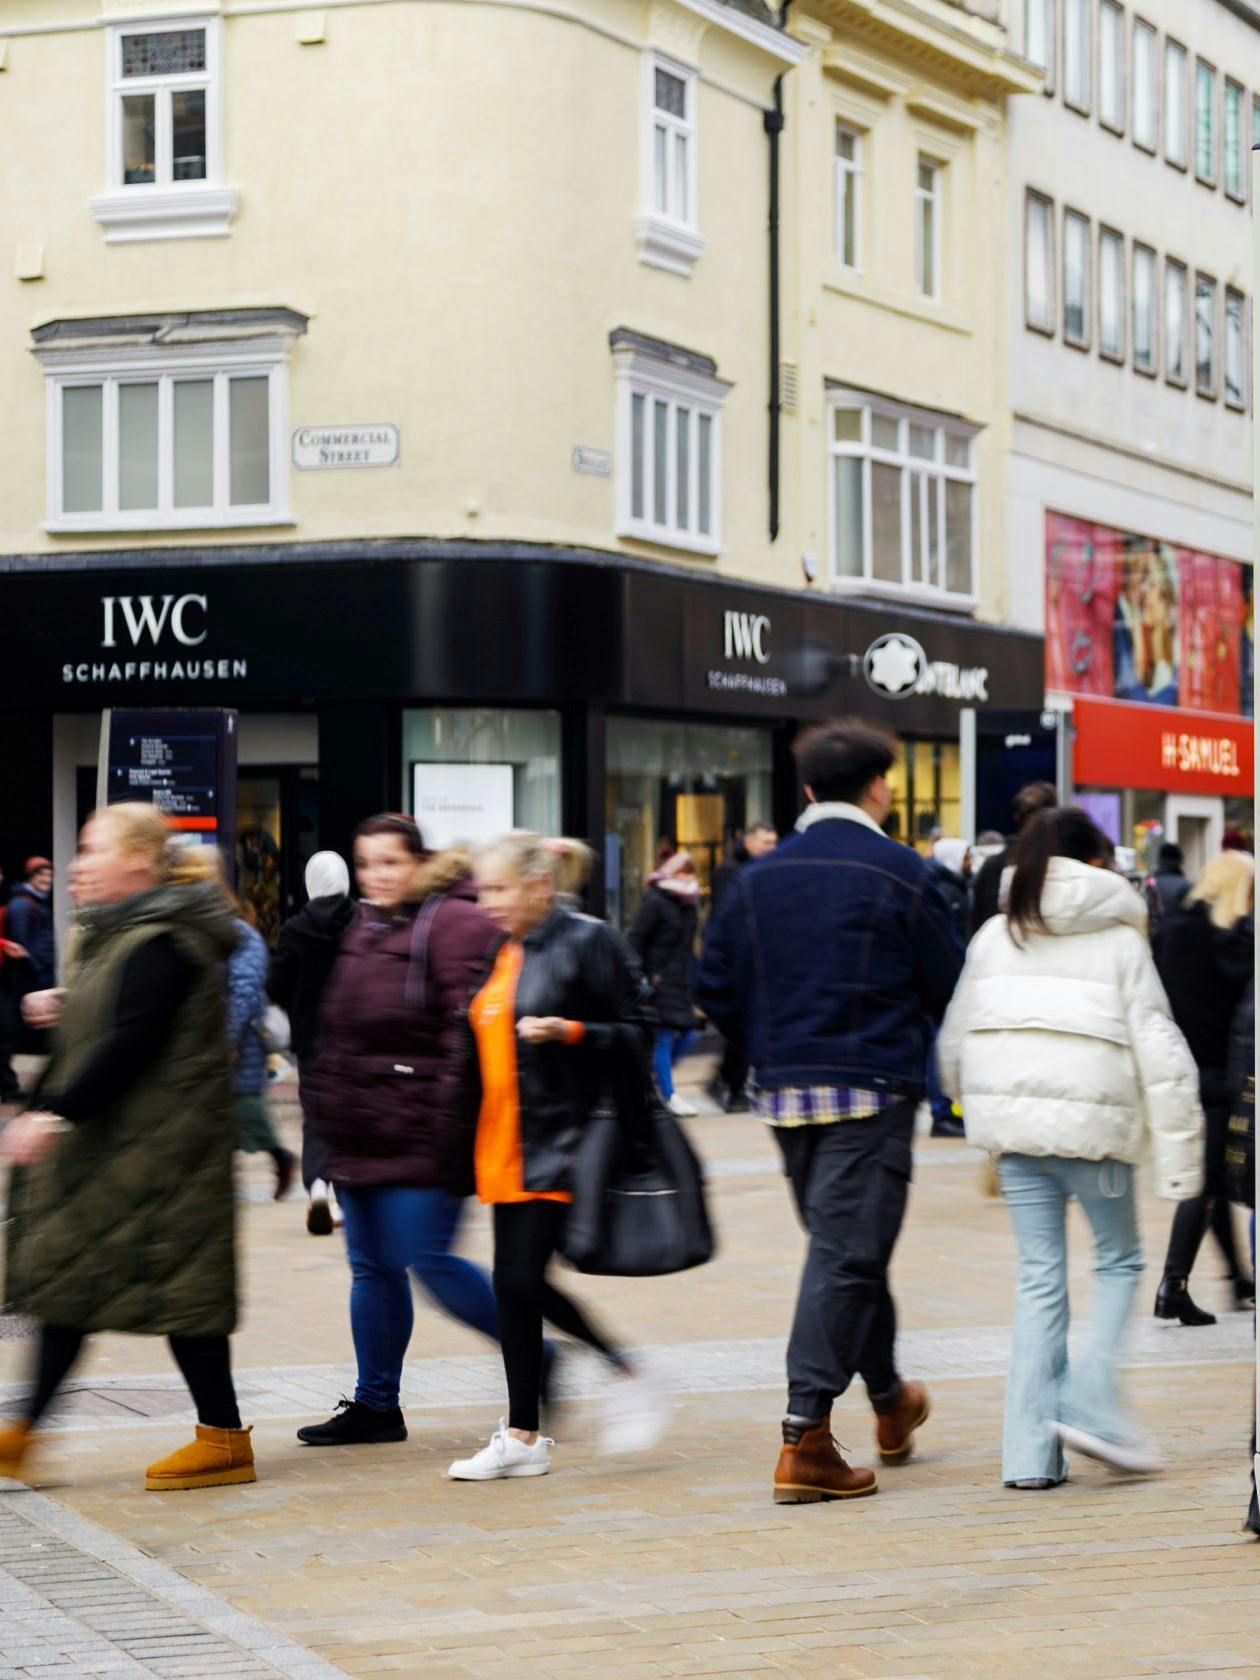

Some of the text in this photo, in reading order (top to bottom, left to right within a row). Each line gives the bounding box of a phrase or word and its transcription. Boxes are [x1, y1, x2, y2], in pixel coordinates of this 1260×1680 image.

[101, 593, 209, 648] IWC
[724, 610, 771, 664] IWC
[62, 659, 247, 683] SCHAFFHAUSEN
[708, 670, 787, 696] SCHAFFHAUSEN
